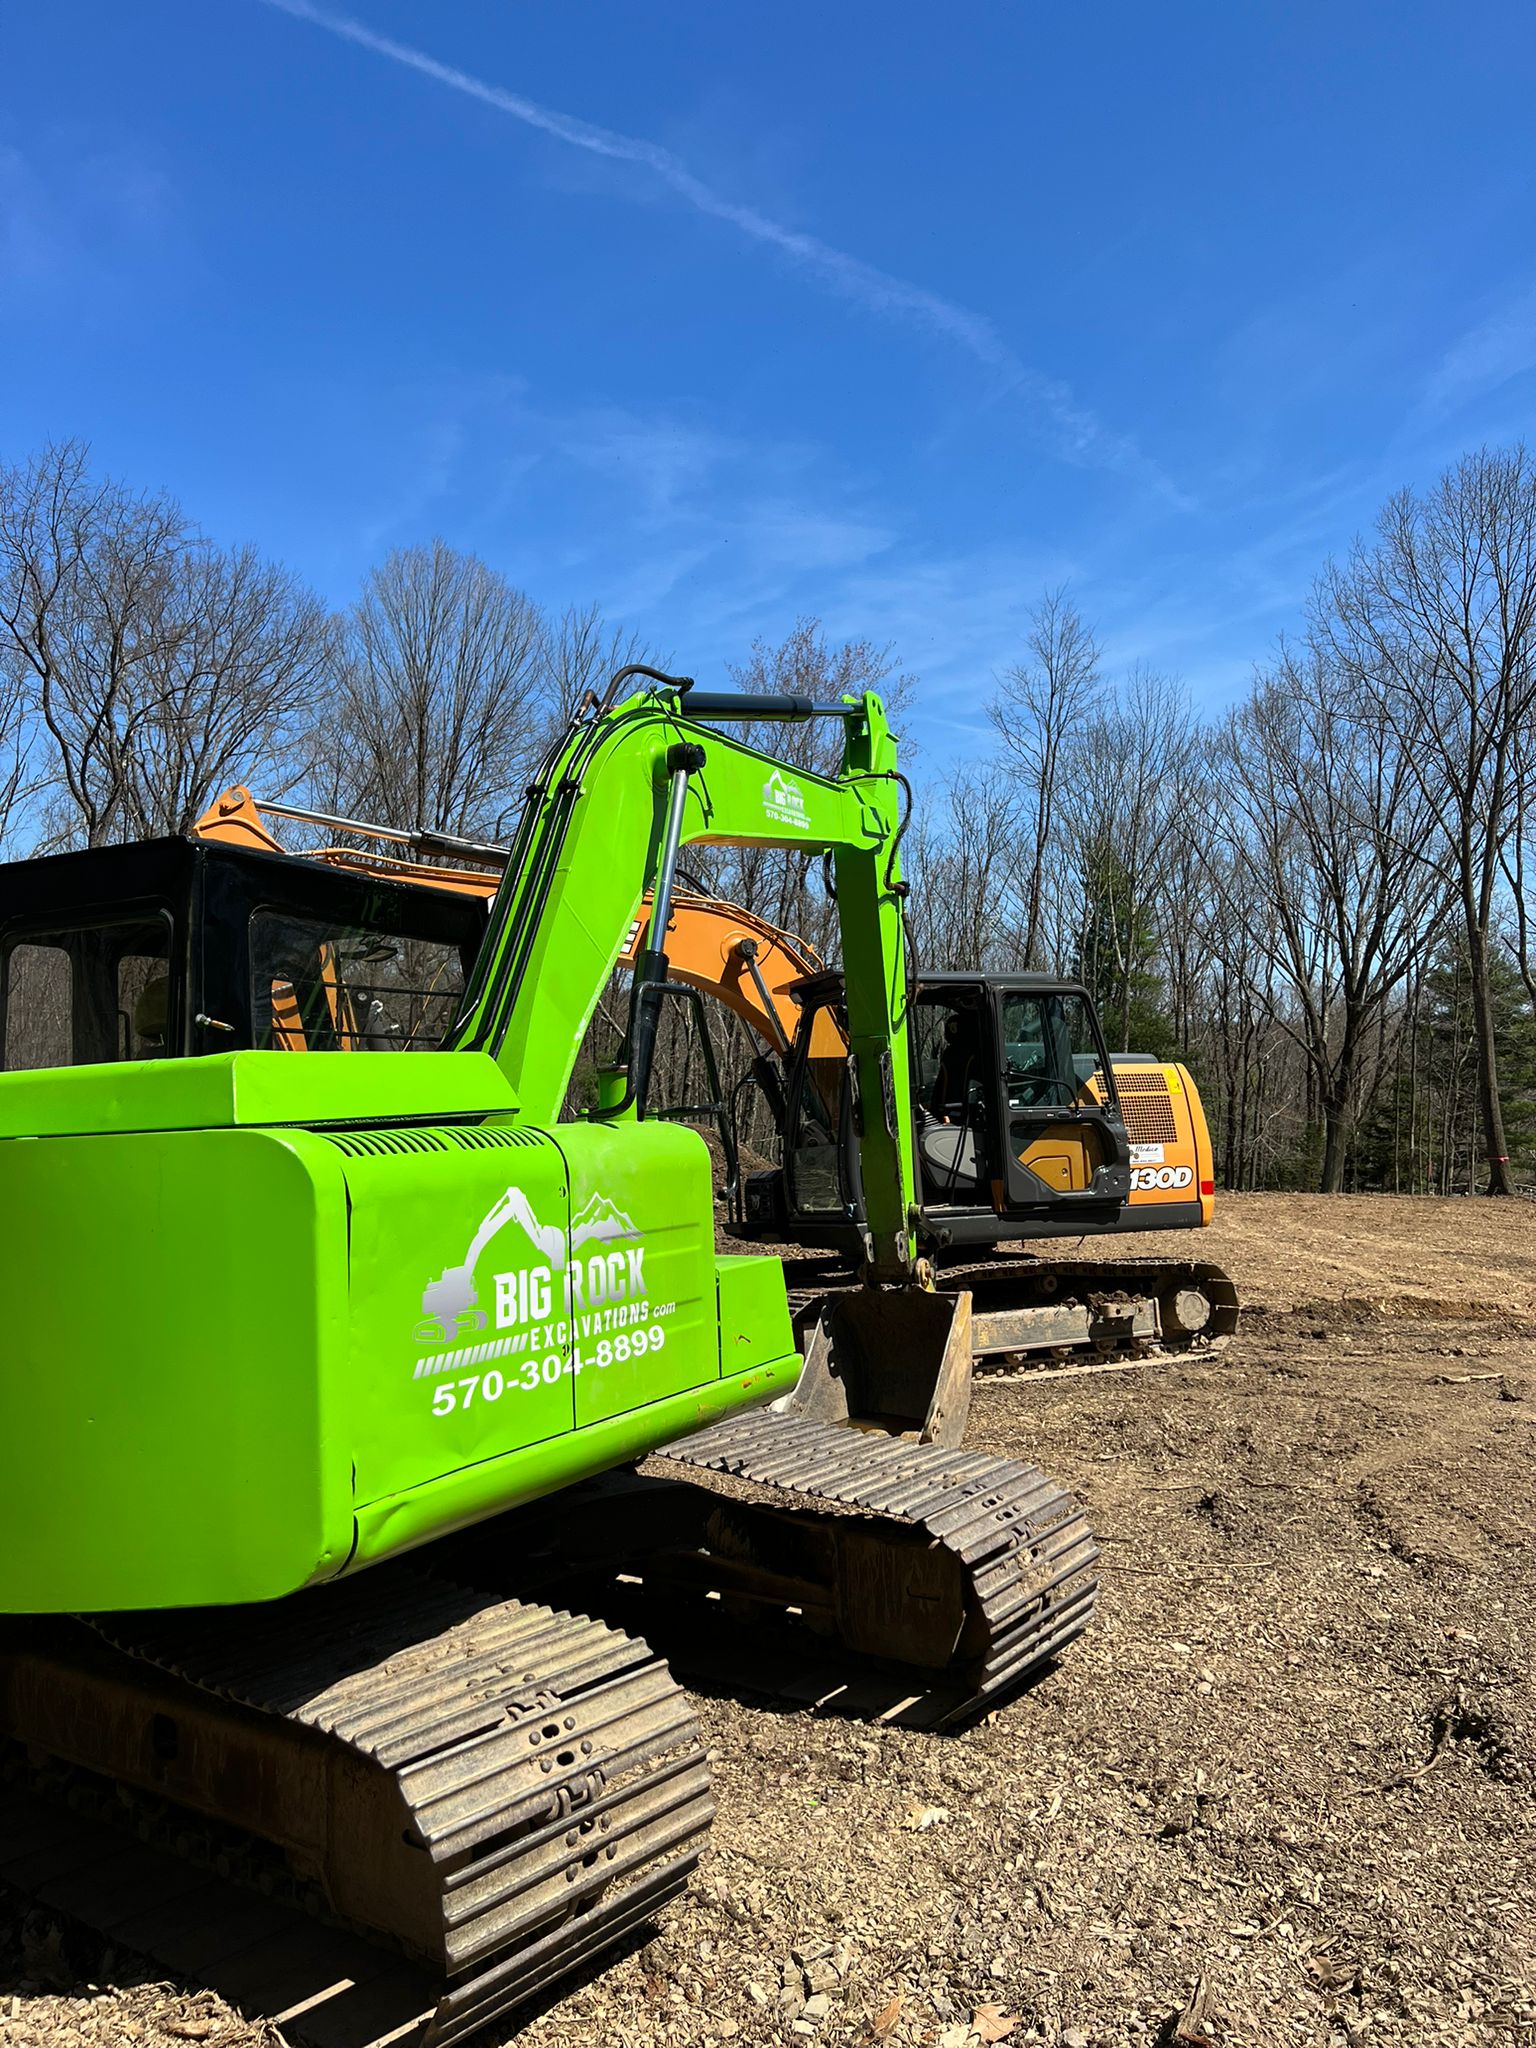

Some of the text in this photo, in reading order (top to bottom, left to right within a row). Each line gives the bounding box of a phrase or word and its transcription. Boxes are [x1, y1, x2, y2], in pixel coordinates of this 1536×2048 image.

[493, 1247, 648, 1330] BIG ROCK
[530, 1300, 650, 1352] EXCAVATIONS
[431, 1324, 666, 1417] 570-304-8899
